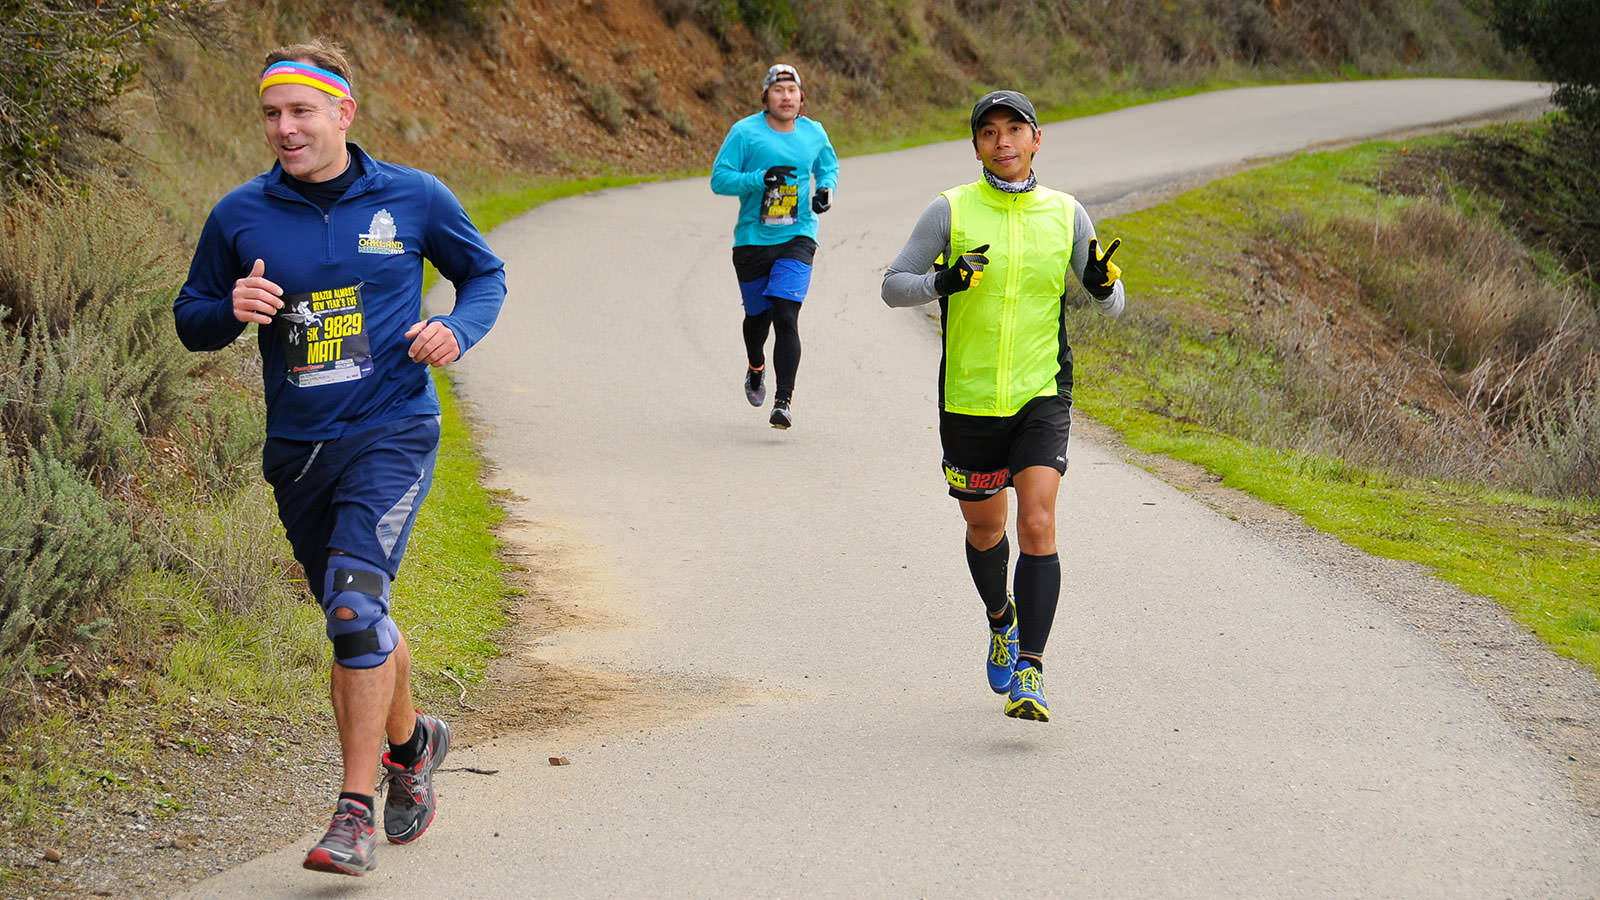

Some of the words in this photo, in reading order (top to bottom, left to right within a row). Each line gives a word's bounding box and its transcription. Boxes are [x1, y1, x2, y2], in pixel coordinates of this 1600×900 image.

[358, 238, 404, 249] OAKLAND
[333, 286, 355, 299] ALMOST
[312, 301, 325, 311] NEW
[326, 298, 346, 309] YEAR'S
[347, 296, 358, 307] EVE
[306, 326, 319, 342] 5K
[324, 312, 362, 339] 9829
[307, 338, 344, 364] MATT
